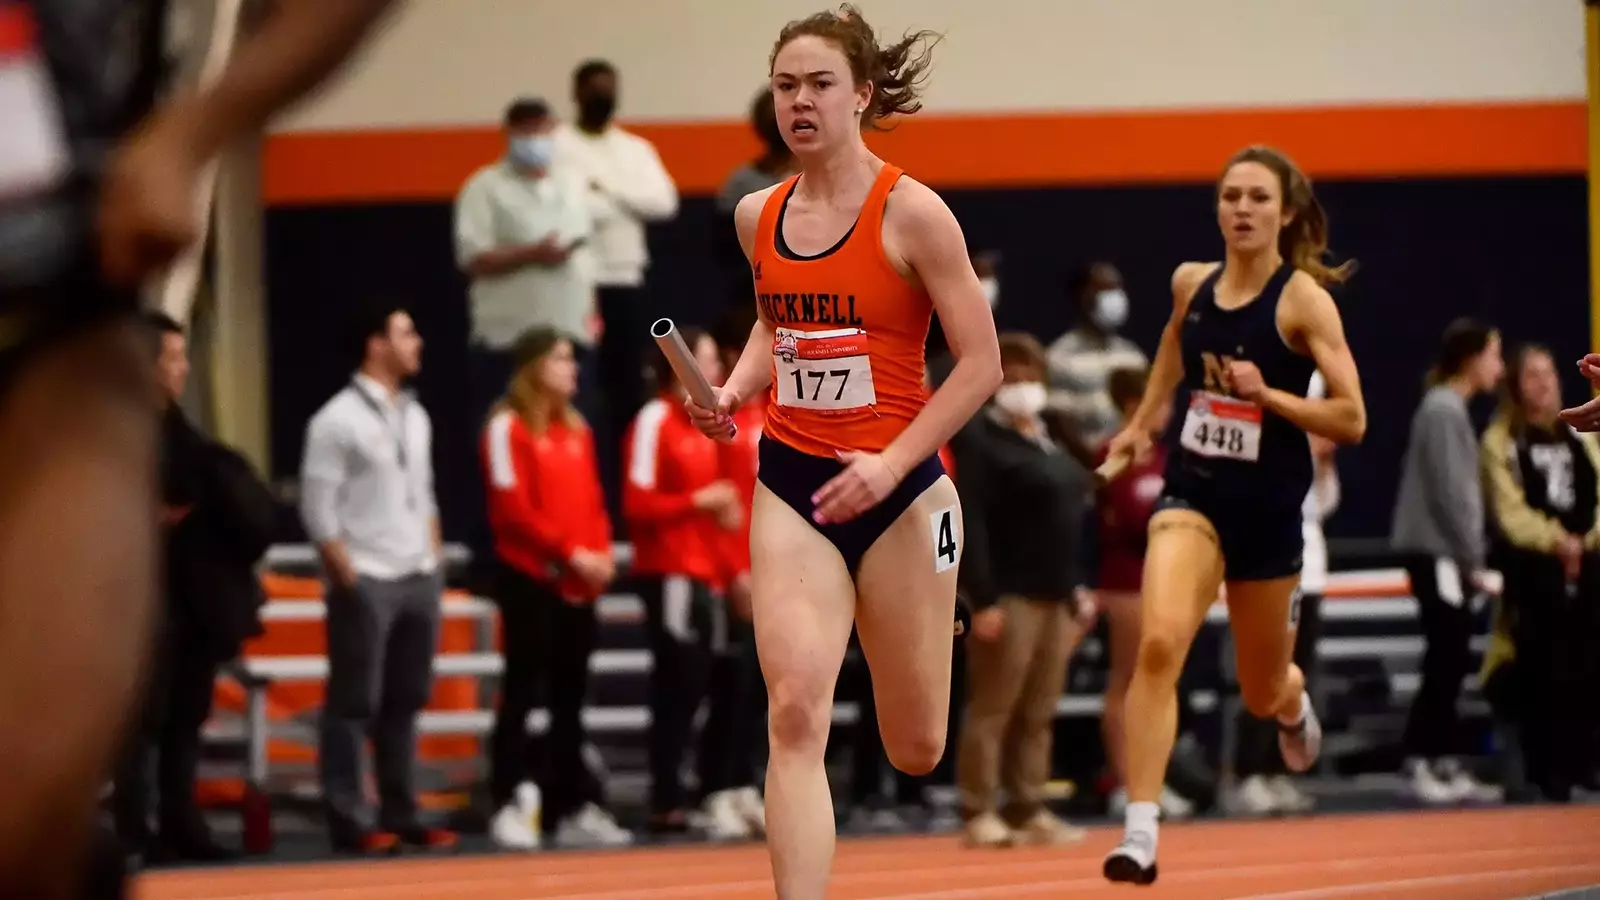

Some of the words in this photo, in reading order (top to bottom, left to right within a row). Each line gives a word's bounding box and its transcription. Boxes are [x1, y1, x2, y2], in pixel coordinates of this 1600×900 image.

[758, 293, 862, 325] UCKNELL
[790, 368, 851, 401] 177
[1194, 422, 1243, 453] 448
[938, 510, 956, 564] 4
